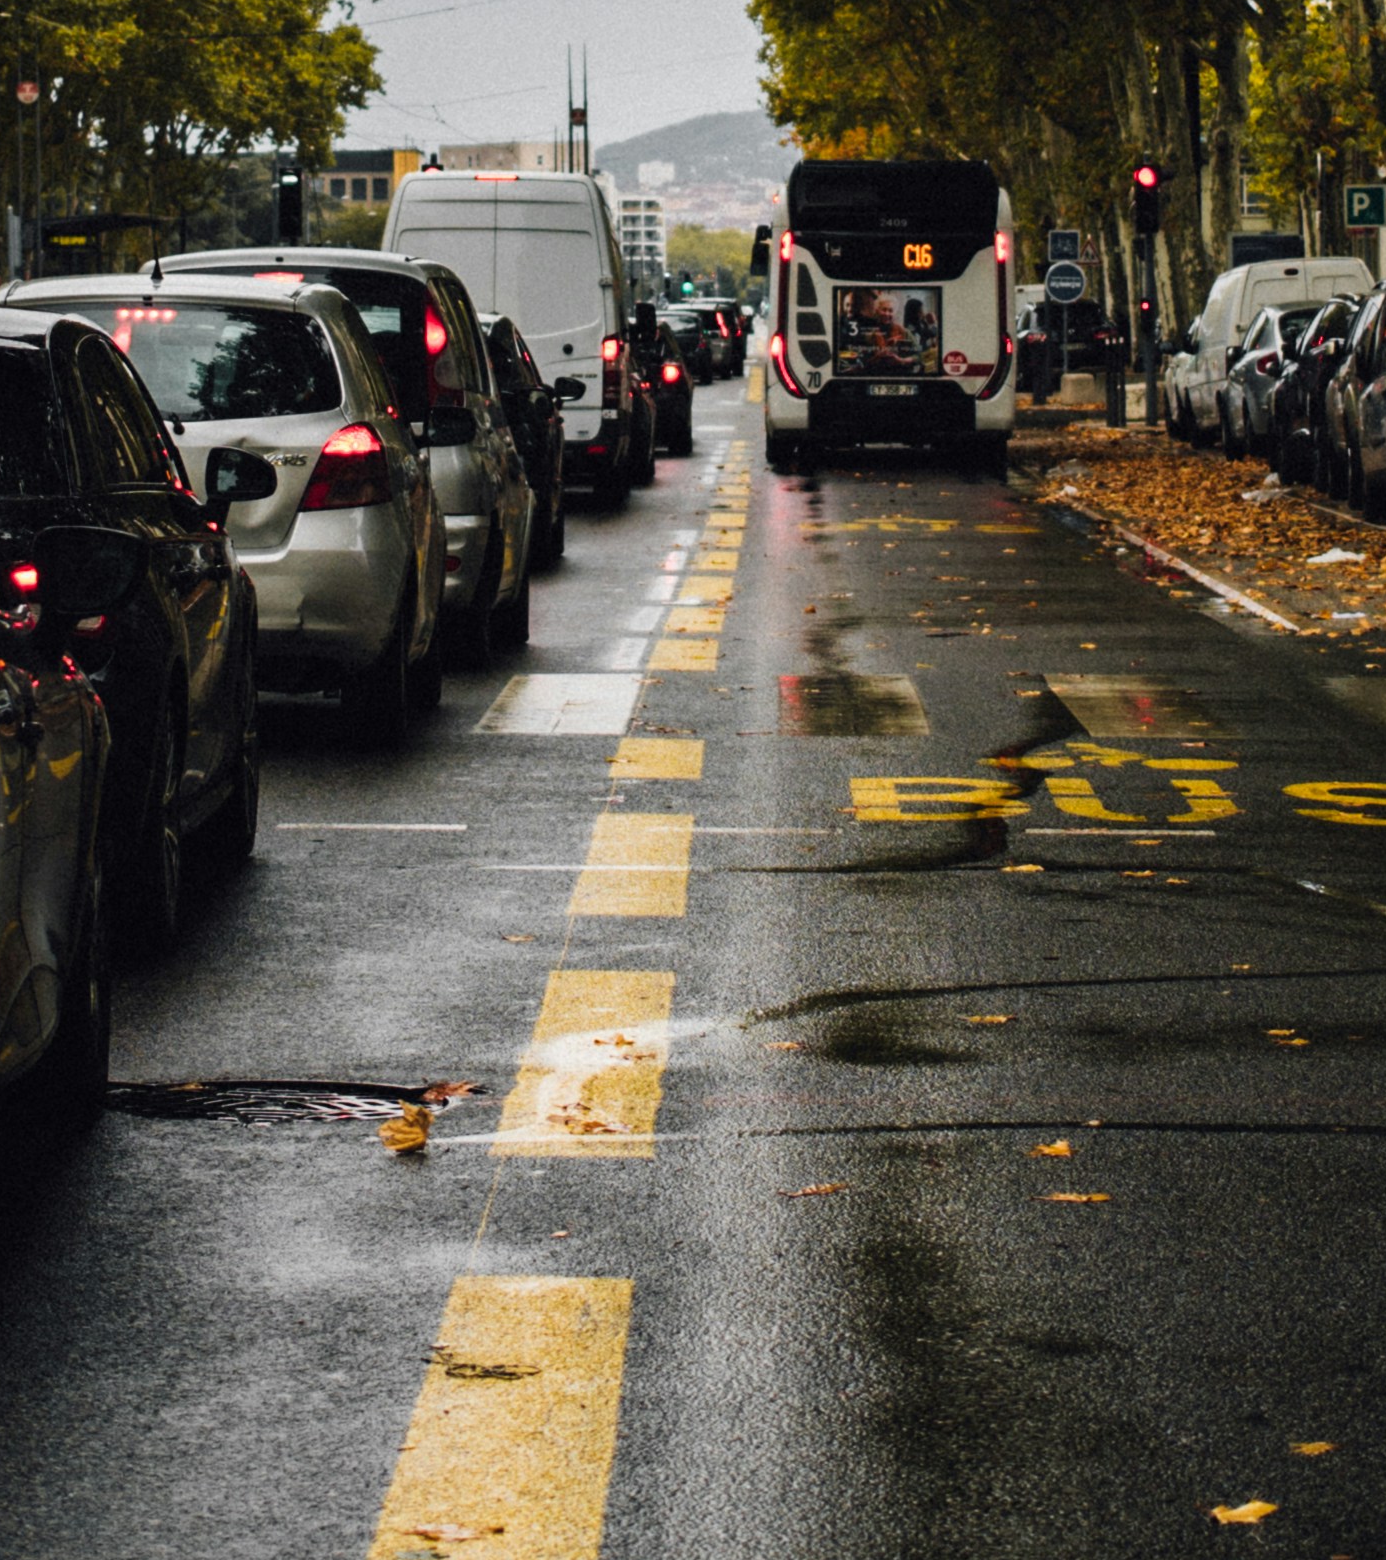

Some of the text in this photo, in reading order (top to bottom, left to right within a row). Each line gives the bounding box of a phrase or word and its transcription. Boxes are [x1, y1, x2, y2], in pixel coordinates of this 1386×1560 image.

[1353, 192, 1371, 217] P
[879, 217, 908, 228] 2409
[903, 243, 934, 268] C16
[848, 320, 860, 337] 3
[807, 371, 821, 388] 70
